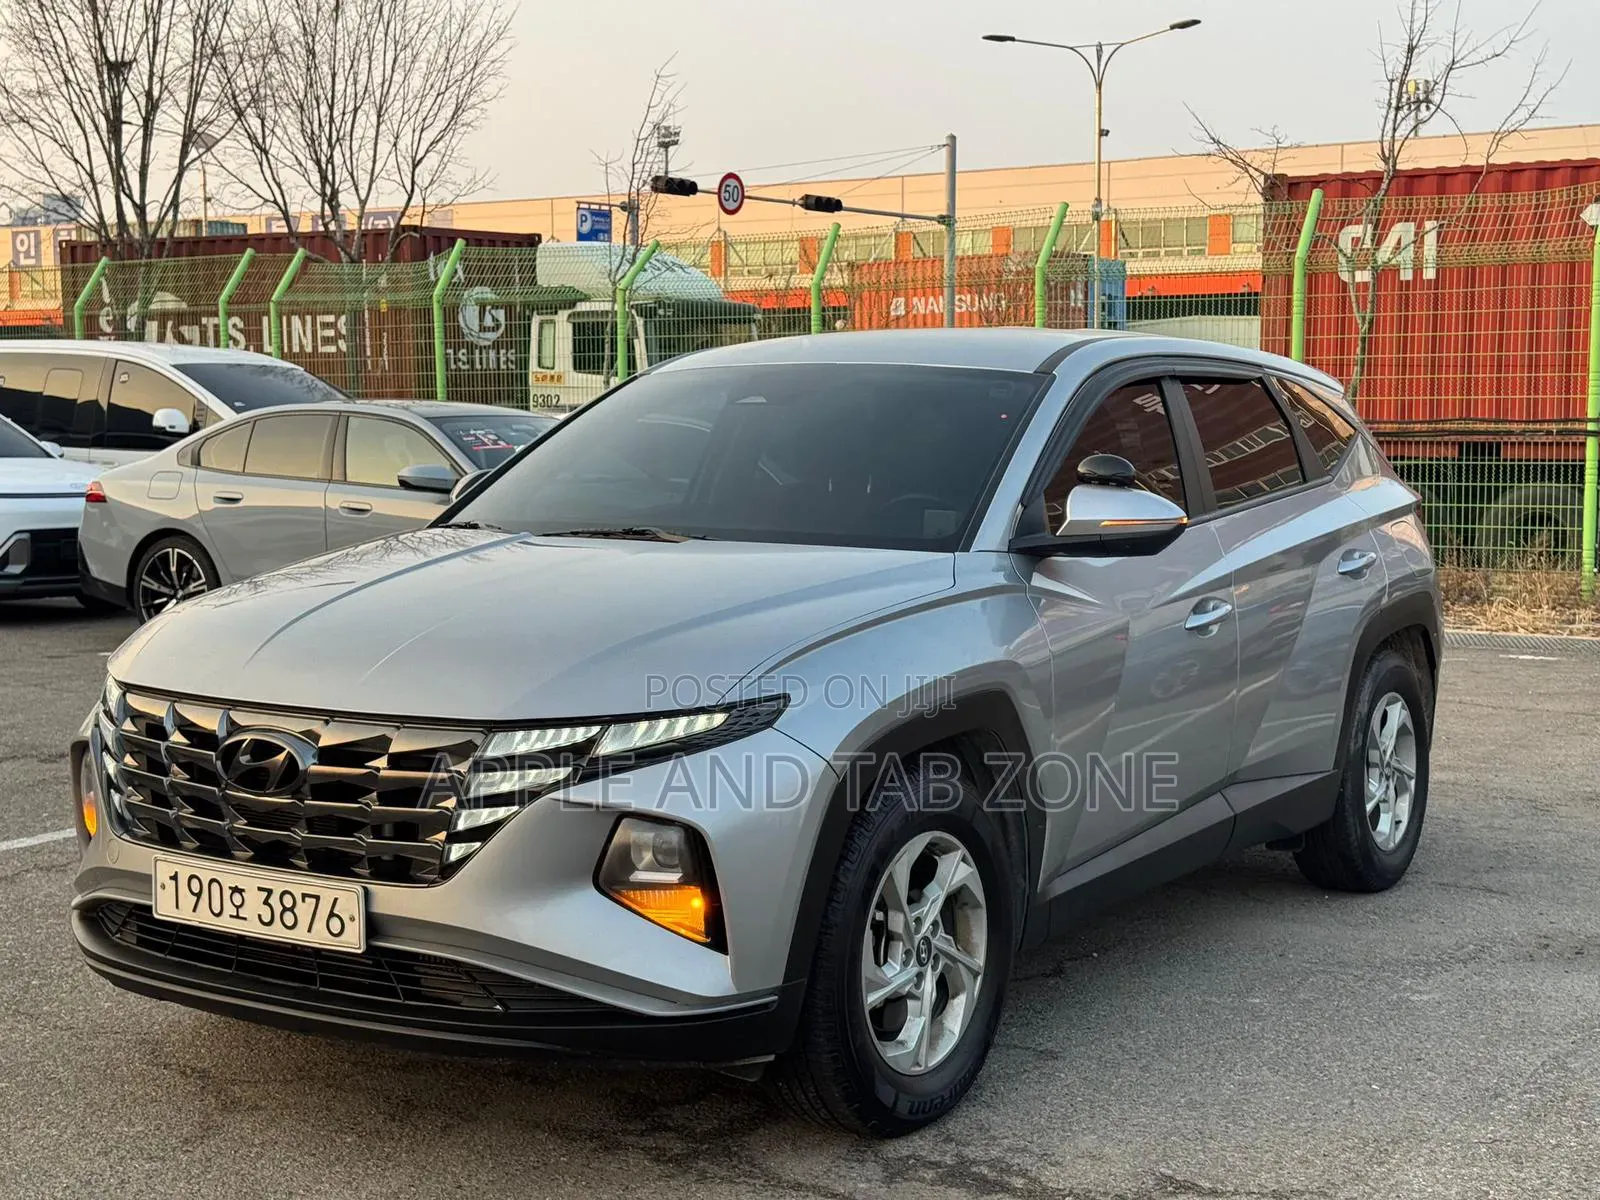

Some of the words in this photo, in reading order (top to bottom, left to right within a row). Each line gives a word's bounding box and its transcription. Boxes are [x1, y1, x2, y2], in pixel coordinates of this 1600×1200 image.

[723, 184, 740, 203] 50
[580, 214, 588, 228] P
[262, 314, 347, 353] LINES
[475, 348, 516, 370] LINES
[532, 393, 561, 408] 9302
[256, 885, 346, 938] 3876
